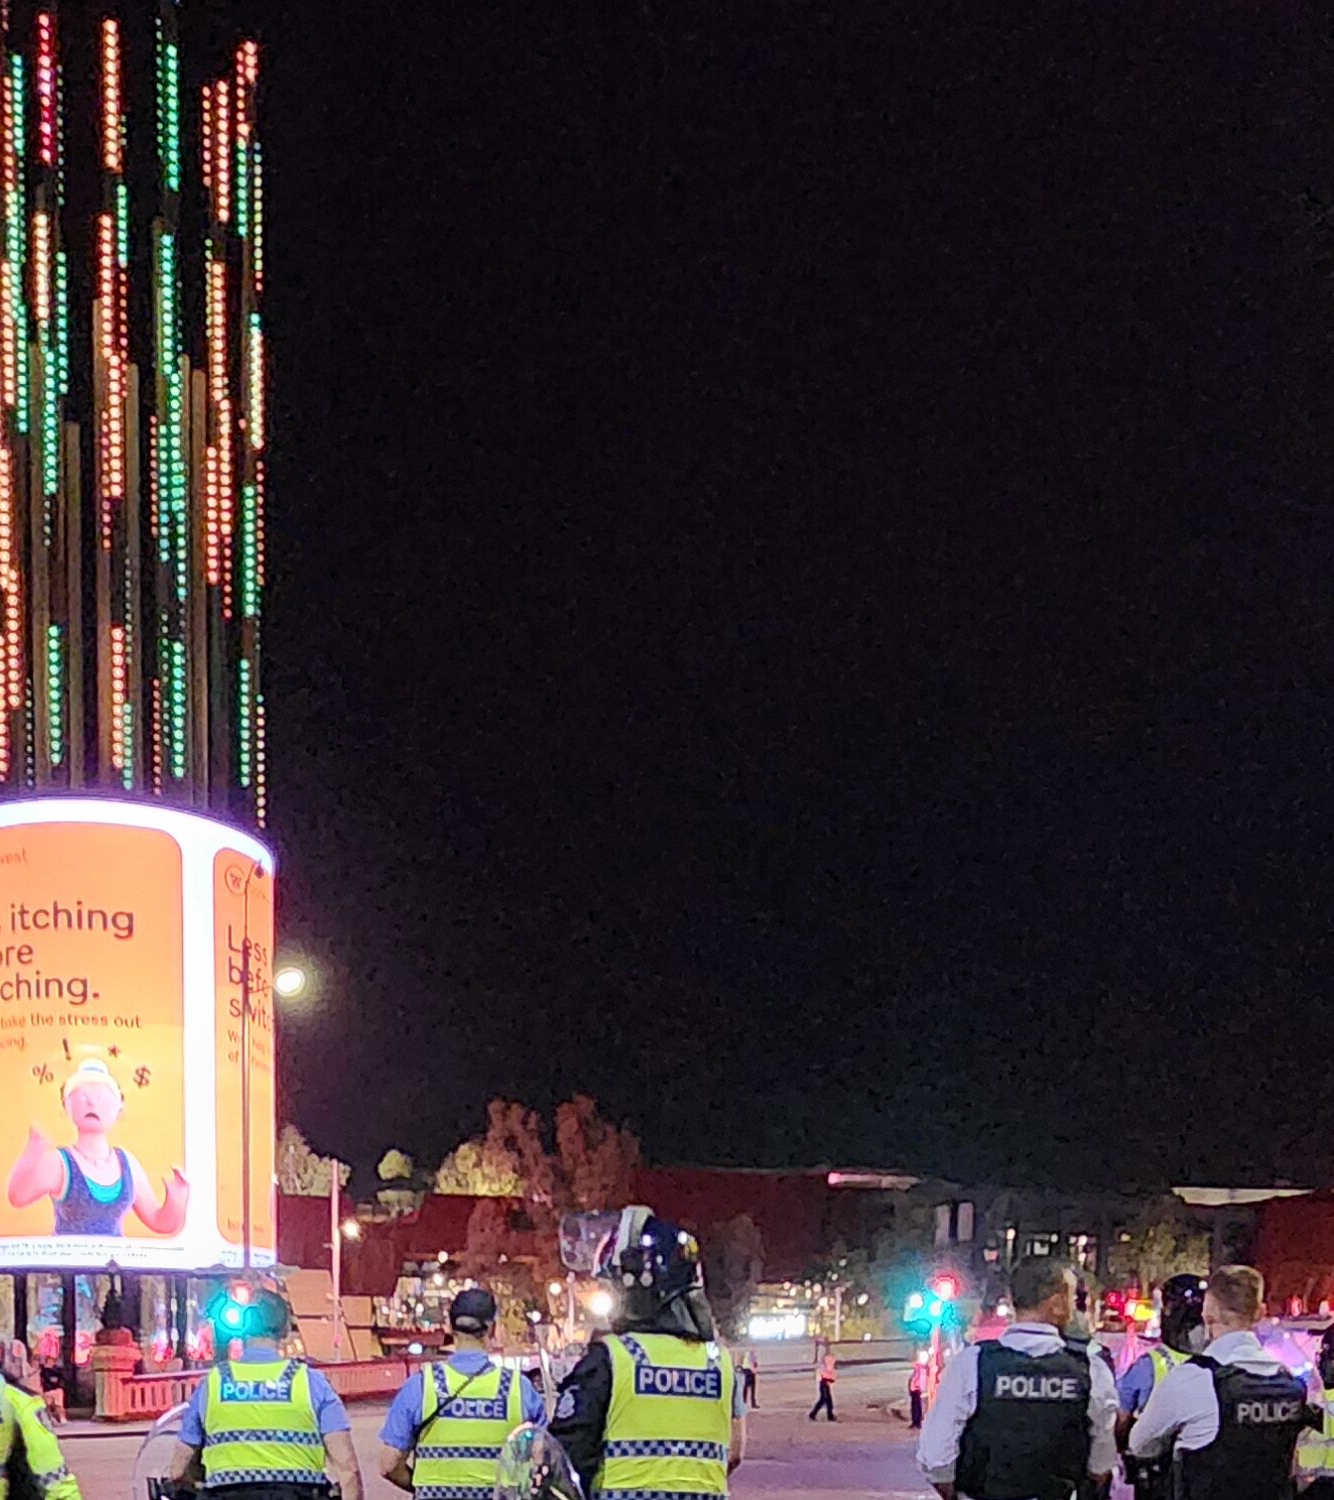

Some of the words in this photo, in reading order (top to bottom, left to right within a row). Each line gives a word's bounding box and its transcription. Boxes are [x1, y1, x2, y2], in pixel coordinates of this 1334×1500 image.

[10, 900, 135, 940] itching
[30, 1013, 54, 1027] the
[58, 1013, 109, 1027] stress
[113, 1015, 143, 1030] out
[32, 1063, 54, 1086] %
[133, 1064, 151, 1089] $
[223, 1381, 288, 1400] POLICE
[639, 1367, 718, 1396] POLICE
[994, 1375, 1079, 1399] POLICE
[1236, 1401, 1300, 1423] POLICE
